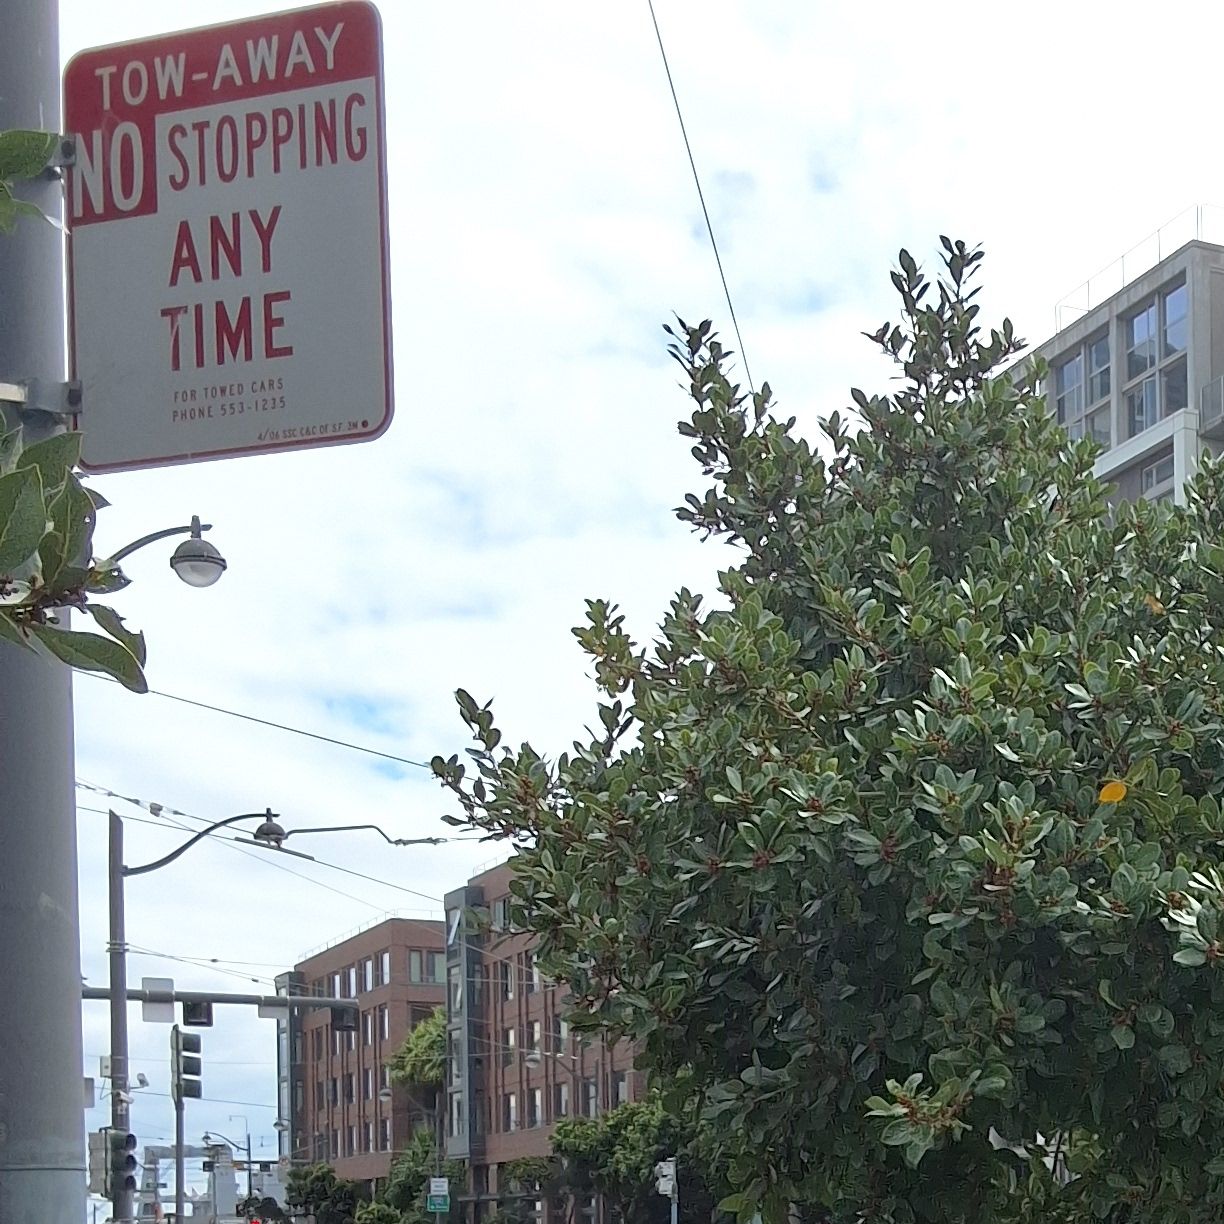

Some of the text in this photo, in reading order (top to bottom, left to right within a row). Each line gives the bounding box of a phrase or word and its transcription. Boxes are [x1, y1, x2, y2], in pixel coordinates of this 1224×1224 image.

[95, 22, 345, 111] TOW-AWAY
[72, 93, 368, 218] NO STOPPING
[168, 205, 282, 288] ANY
[160, 291, 293, 371] TIME
[172, 396, 286, 422] PHONE 553-1235
[174, 378, 284, 403] FOR TOWED CARS
